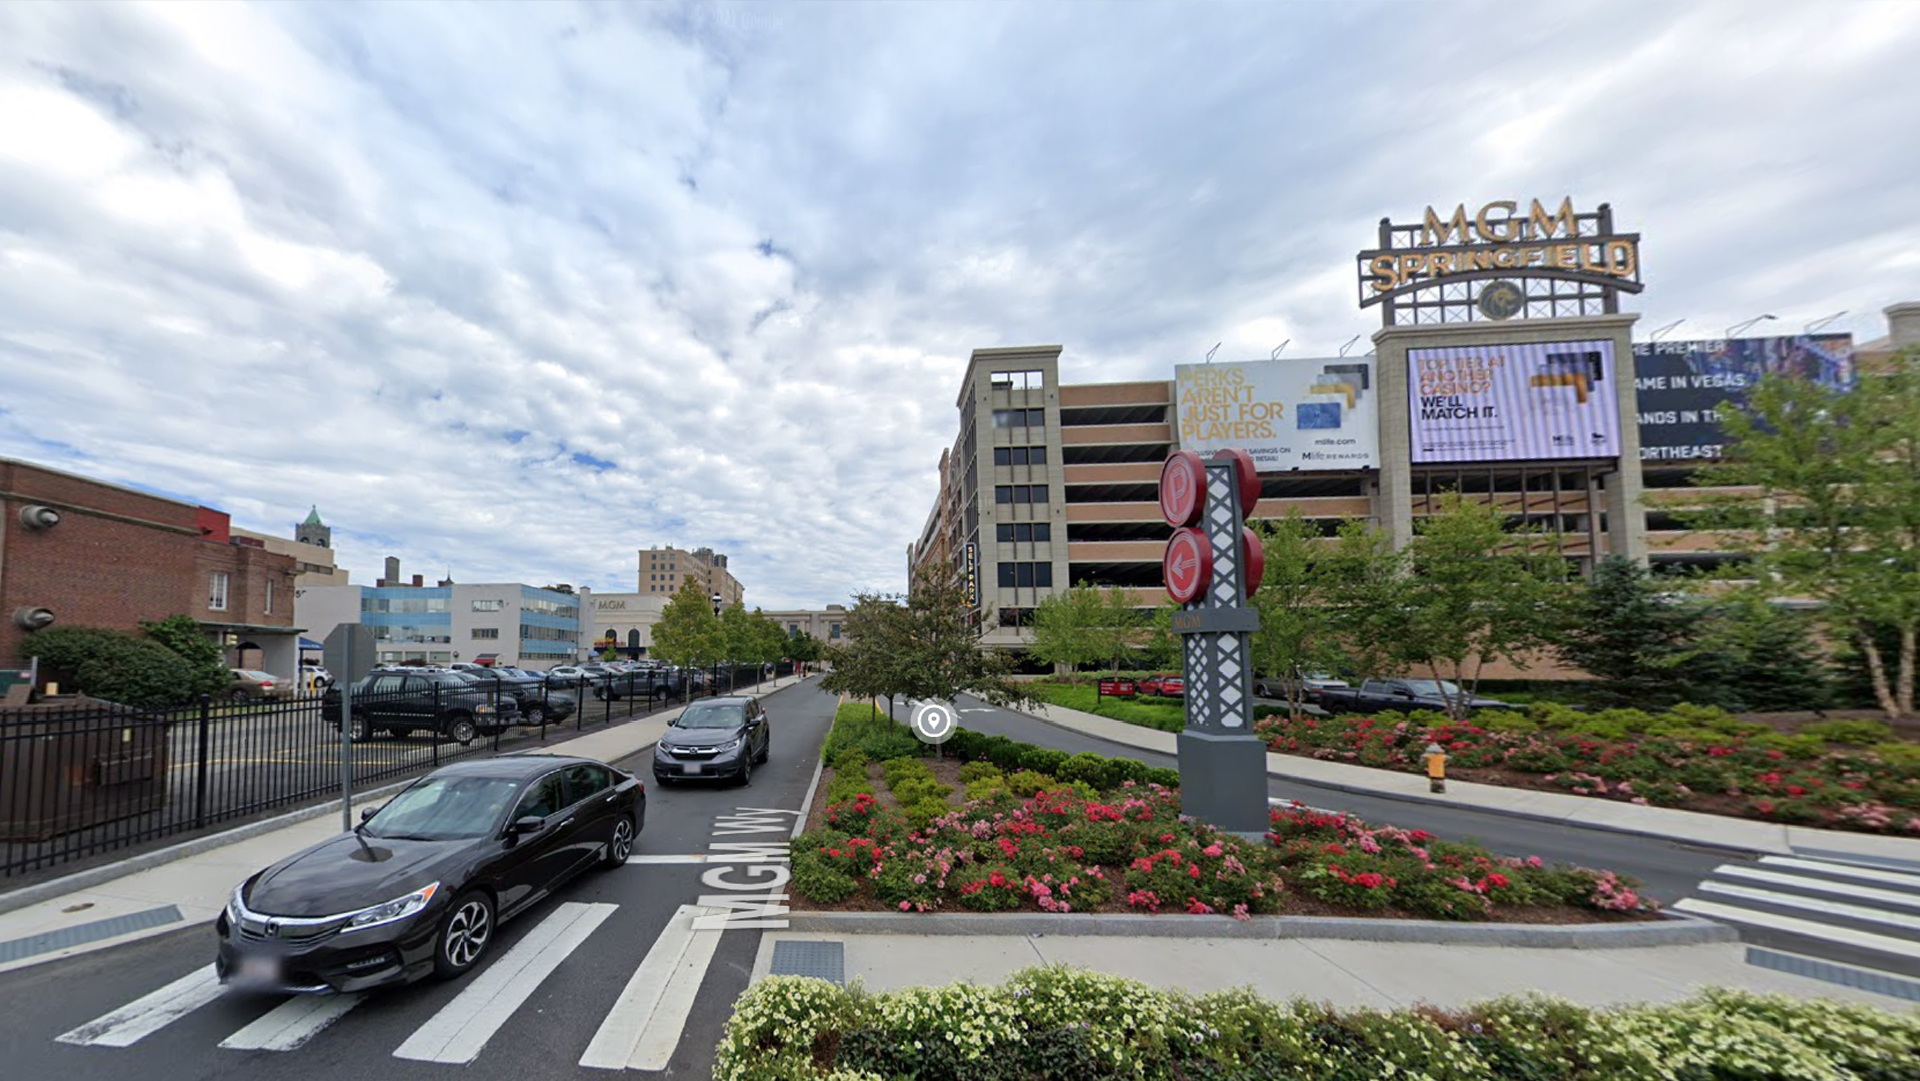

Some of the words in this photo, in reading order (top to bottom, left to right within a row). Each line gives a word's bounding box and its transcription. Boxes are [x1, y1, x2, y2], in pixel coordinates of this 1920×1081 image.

[1418, 195, 1580, 246] MGM
[1370, 239, 1636, 292] SPRINGFIELD
[1179, 367, 1246, 388] PERKS
[1635, 375, 1668, 390] AME
[1670, 375, 1688, 389] IN
[1690, 372, 1746, 388] VEGAS
[1181, 385, 1255, 405] AREN'T
[1420, 395, 1463, 407] WE'LL
[1182, 403, 1231, 424] JUST
[1239, 401, 1285, 421] FOR
[1421, 407, 1479, 420] MATCH
[1482, 406, 1498, 418] IT.
[1636, 410, 1677, 425] ANDS
[1680, 410, 1699, 423] IN
[1181, 420, 1277, 442] PLAYERS.
[1638, 444, 1724, 460] ORTHEAST
[1171, 467, 1188, 512] P
[598, 600, 626, 610] MGM
[1175, 614, 1201, 629] MGM
